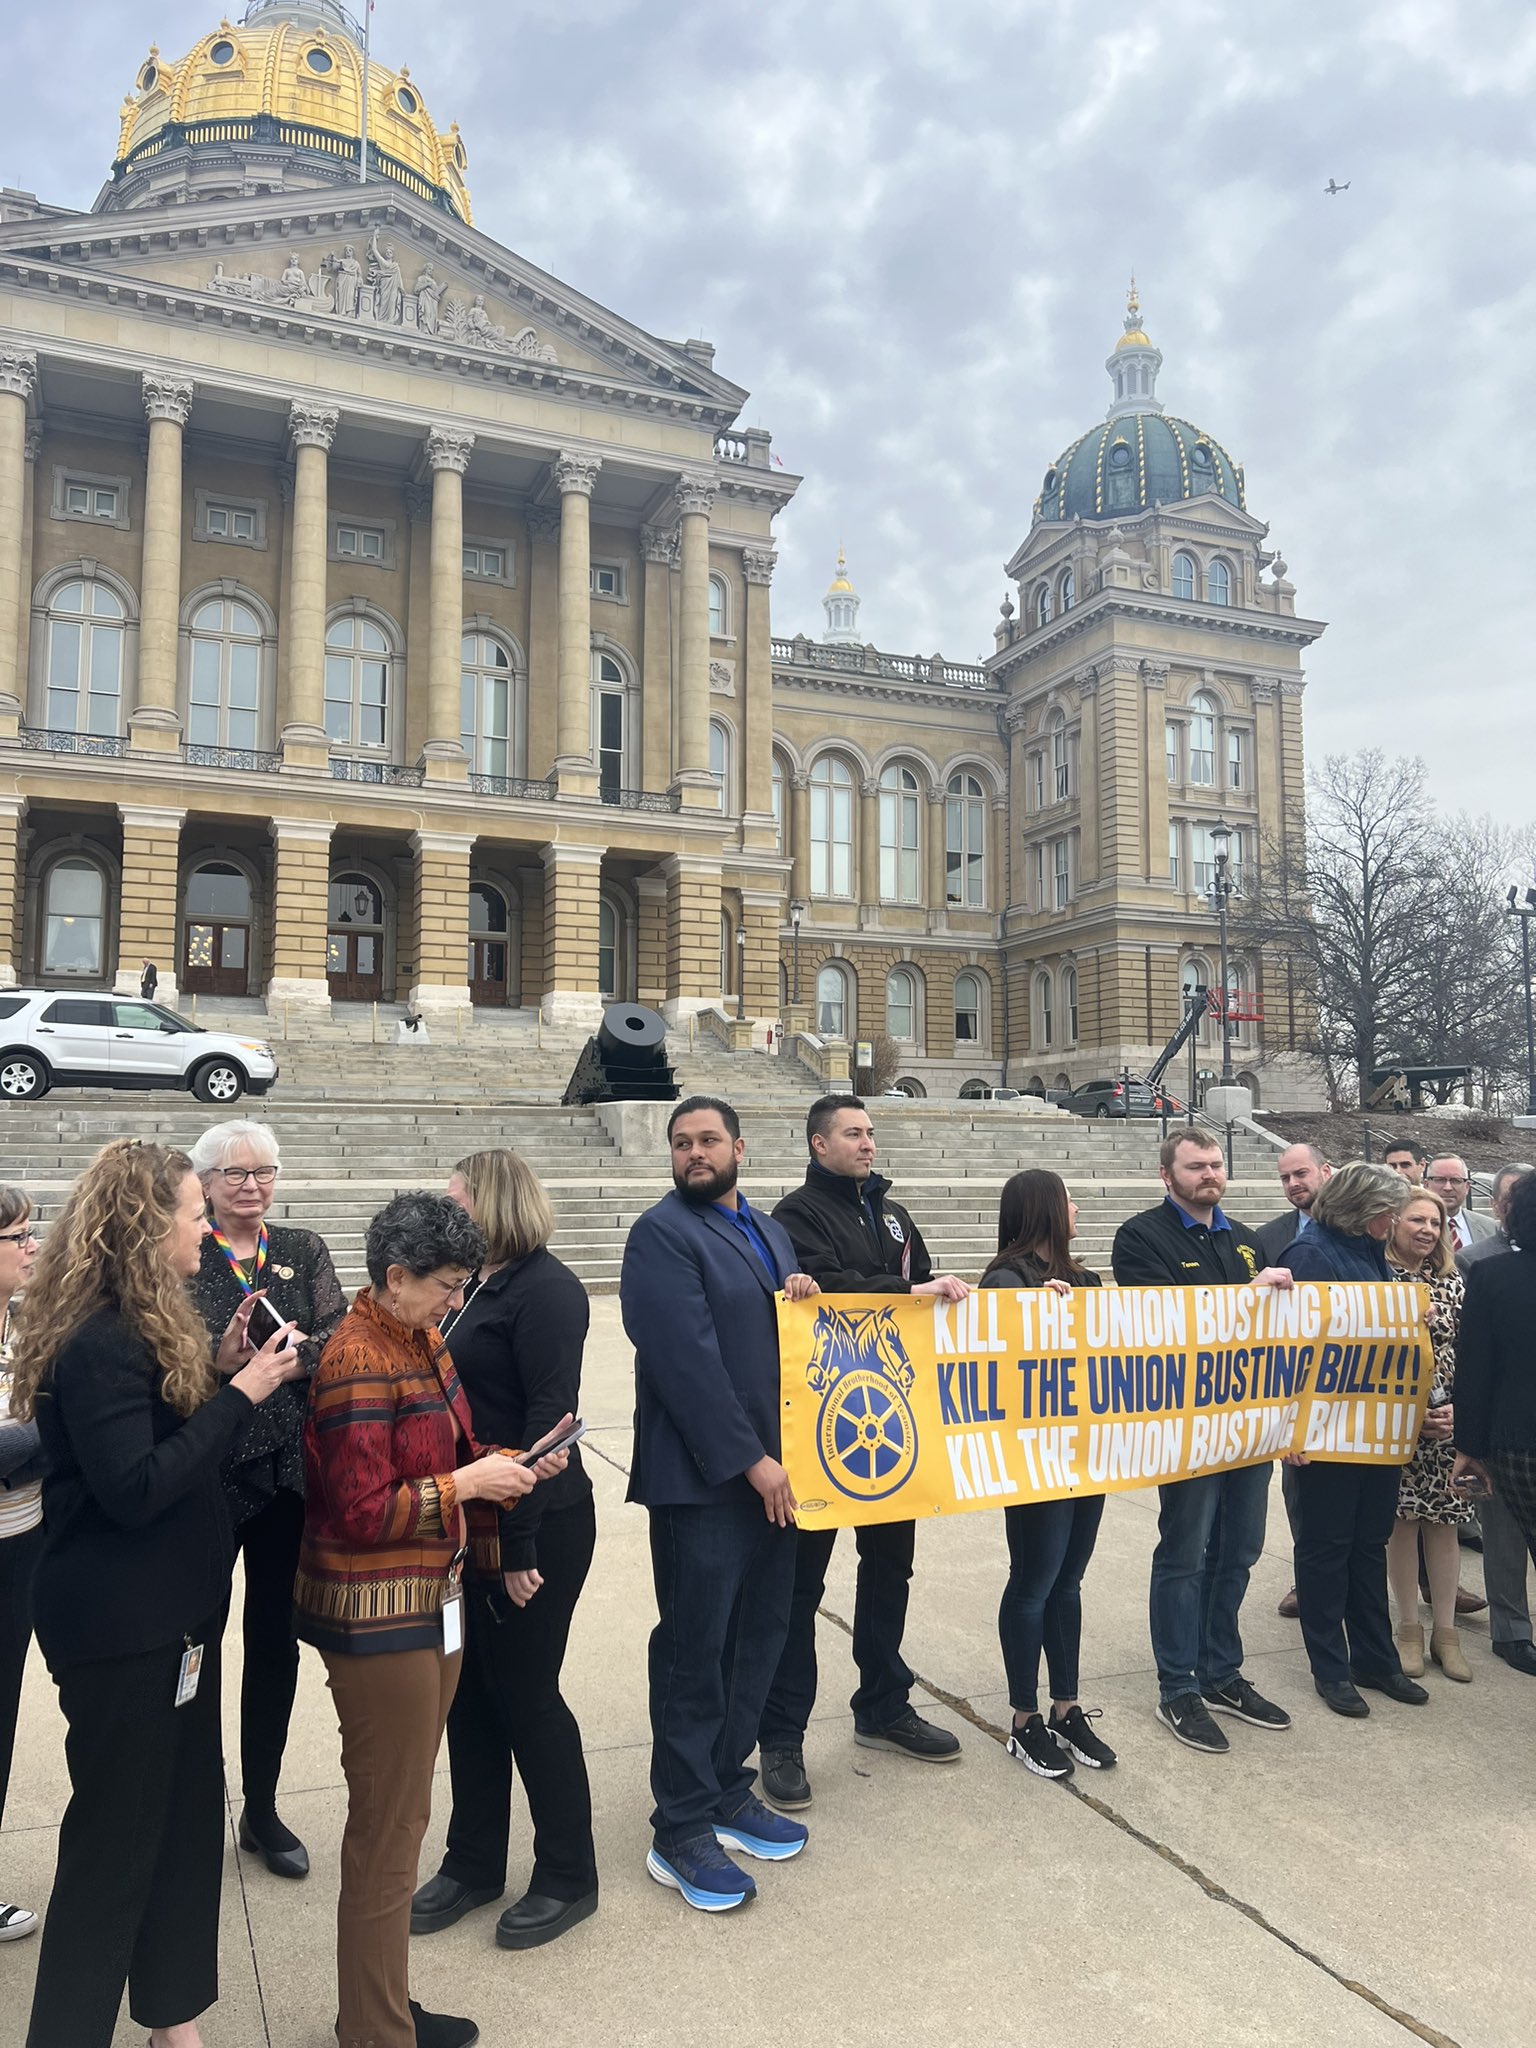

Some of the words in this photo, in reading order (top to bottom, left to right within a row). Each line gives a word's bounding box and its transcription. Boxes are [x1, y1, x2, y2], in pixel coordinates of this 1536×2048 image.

[934, 1292, 1007, 1354] KILL
[1016, 1290, 1077, 1351] THE
[1086, 1288, 1187, 1348] UNION
[1194, 1284, 1321, 1345] BUSTING
[1327, 1284, 1419, 1338] BILL!!!
[826, 1389, 844, 1461] International
[843, 1373, 889, 1393] Brotherhood
[889, 1391, 898, 1401] of
[897, 1401, 912, 1456] Teamsters
[937, 1361, 1006, 1425] KILL
[1018, 1357, 1079, 1419] THE
[1087, 1353, 1186, 1414] UNION
[1194, 1345, 1315, 1407] BUSTING
[1315, 1343, 1420, 1395] BILL!!!
[945, 1430, 1018, 1500] KILL
[1016, 1425, 1080, 1490] THE
[1087, 1417, 1184, 1482] UNION
[1187, 1400, 1299, 1471] BUSTING
[1304, 1400, 1416, 1455] BILL!!!
